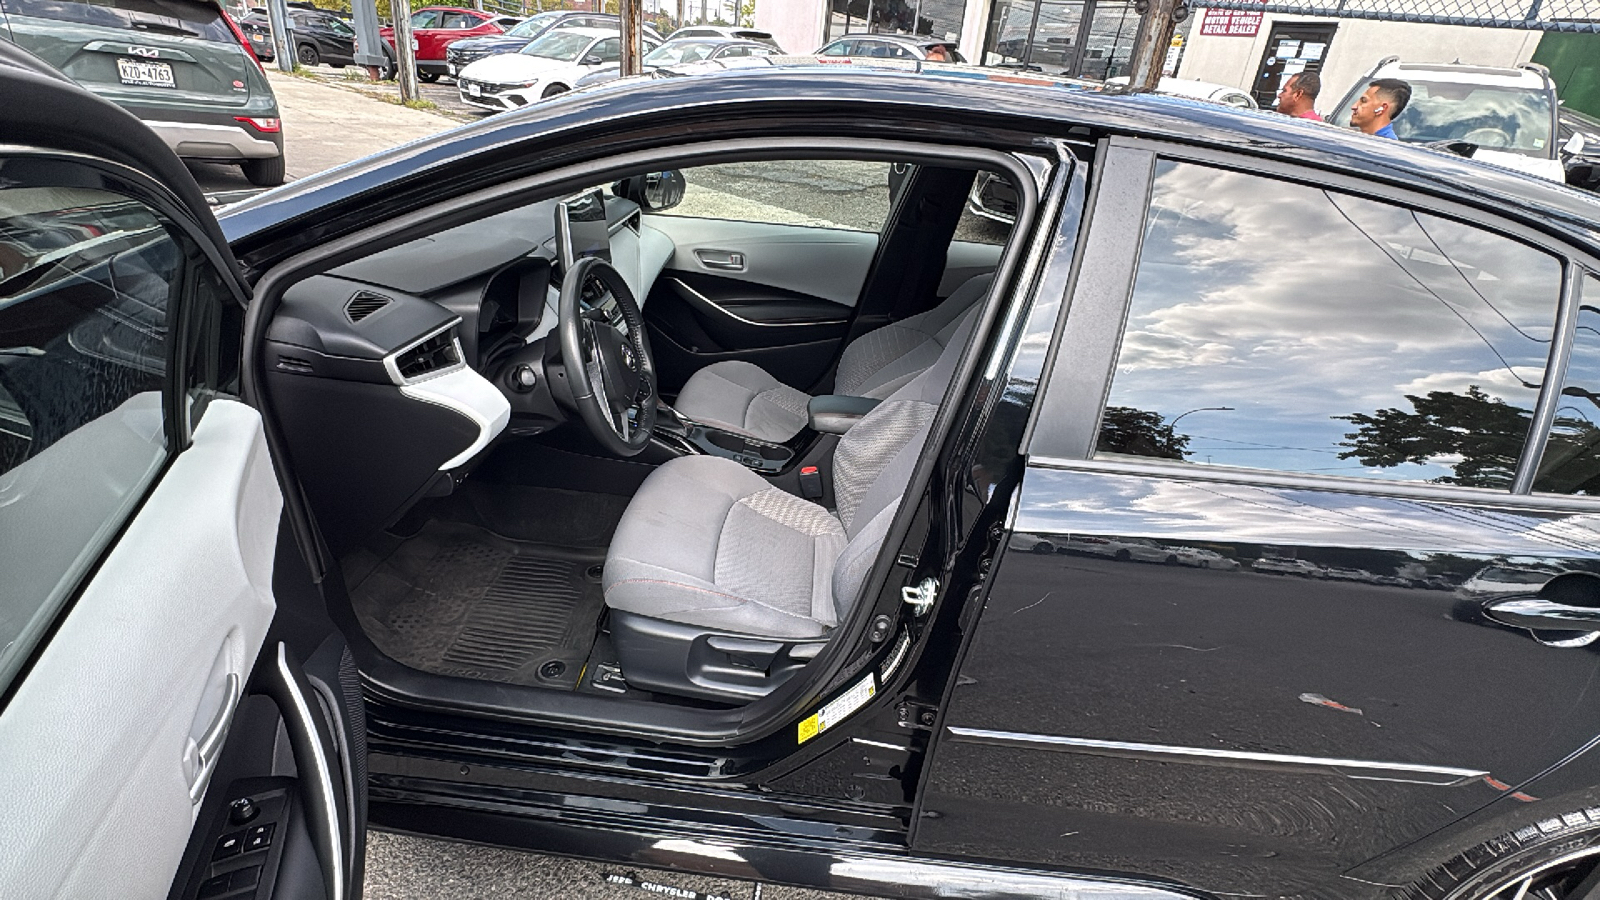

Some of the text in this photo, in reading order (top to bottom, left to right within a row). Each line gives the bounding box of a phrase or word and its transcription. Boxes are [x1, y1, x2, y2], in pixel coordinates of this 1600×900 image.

[1205, 16, 1262, 26] MOTOR VEHICLE
[1203, 25, 1257, 34] RETAIL DEALER
[641, 881, 697, 899] CHRYSLER
